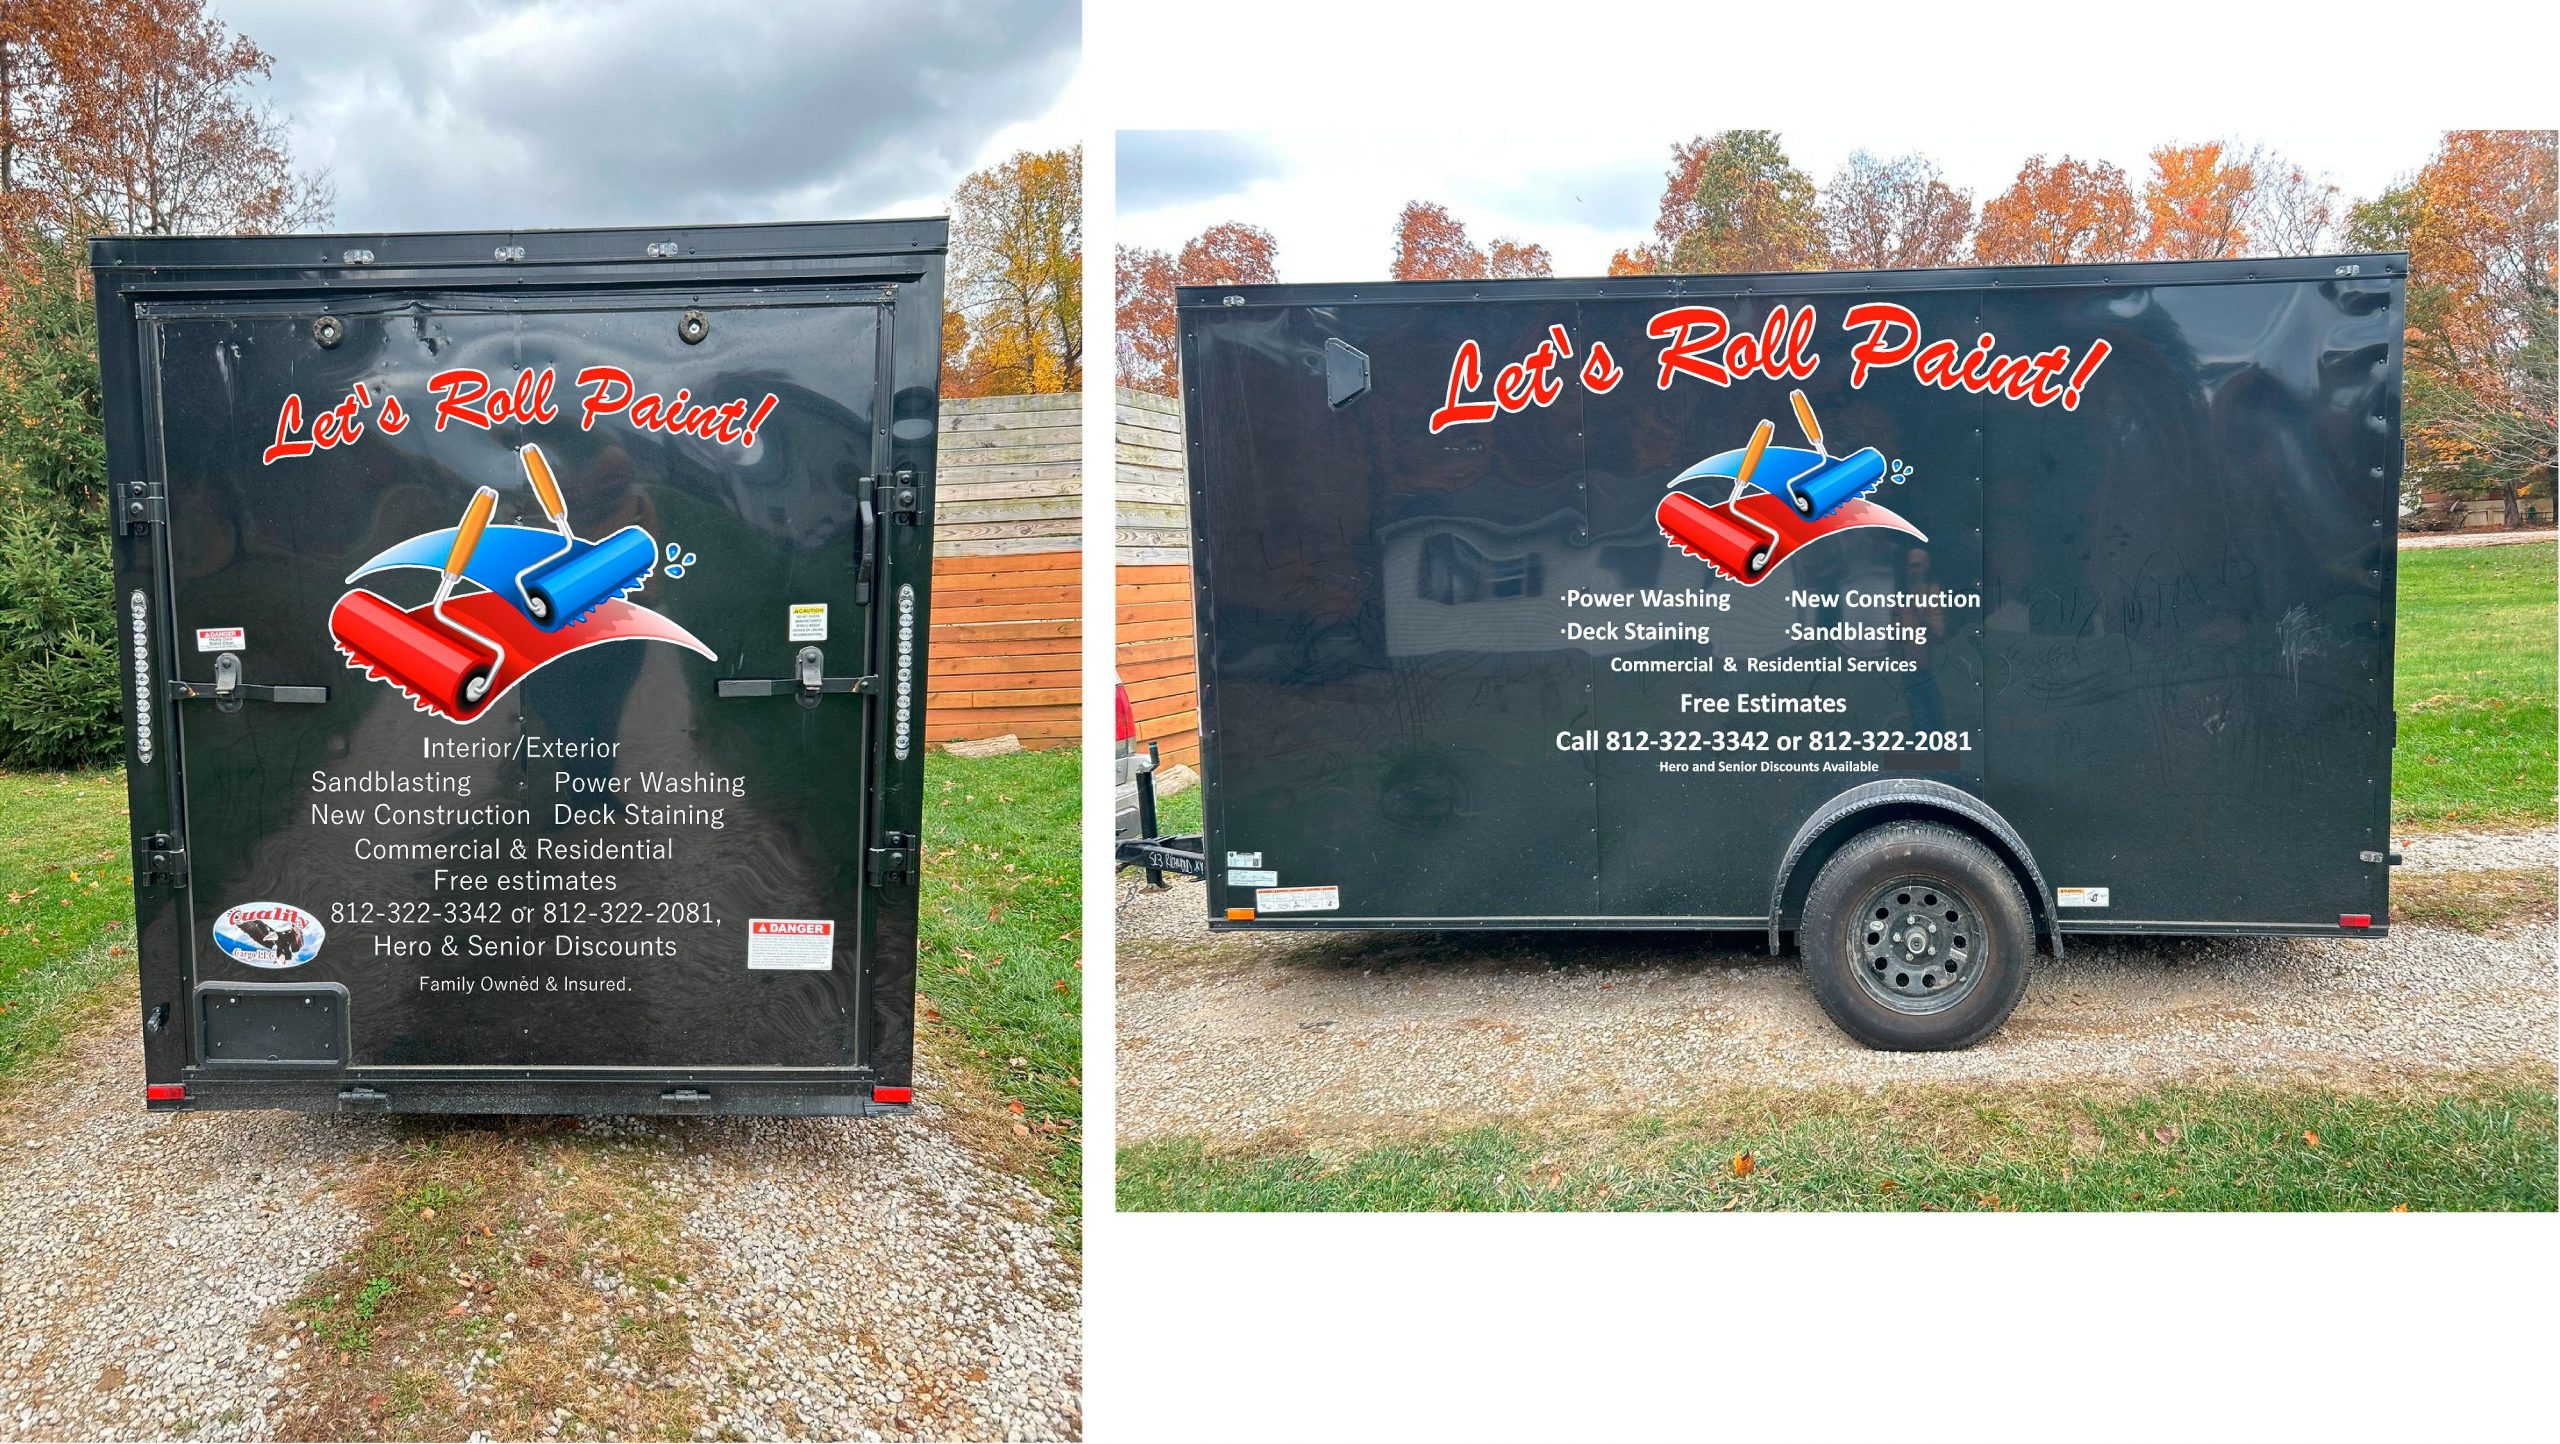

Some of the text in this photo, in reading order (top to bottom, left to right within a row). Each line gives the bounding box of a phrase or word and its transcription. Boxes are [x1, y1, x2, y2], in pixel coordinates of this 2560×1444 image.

[1430, 303, 2112, 433] Let's Roll Paint!
[263, 366, 778, 464] Let's Roll Paint!
[1640, 589, 1730, 611] Washing
[1846, 589, 1980, 608] Construction
[1625, 622, 1710, 644] Staining
[1611, 656, 1917, 672] Commercial & Residential Services
[1681, 693, 1846, 712] Free Estimates
[423, 735, 620, 761] Interior/Exterior
[1557, 730, 1972, 751] Call 812-322-3342 or 812-322-2081
[1659, 760, 1879, 772] Hero and Senior Discounts Available
[312, 771, 471, 797] Sandblasting
[556, 771, 745, 798] Power Washing
[312, 804, 530, 826] New Construction
[556, 803, 724, 830] Deck Staining
[355, 838, 672, 860] Commercial & Residential
[435, 870, 617, 891] Free estimates
[331, 901, 720, 927] 812-322-3342 or 812-322-2081,
[769, 924, 824, 934] DANGER
[375, 935, 677, 957] Hero & Senior Discounts
[421, 976, 632, 995] Family Owned & Insured.
